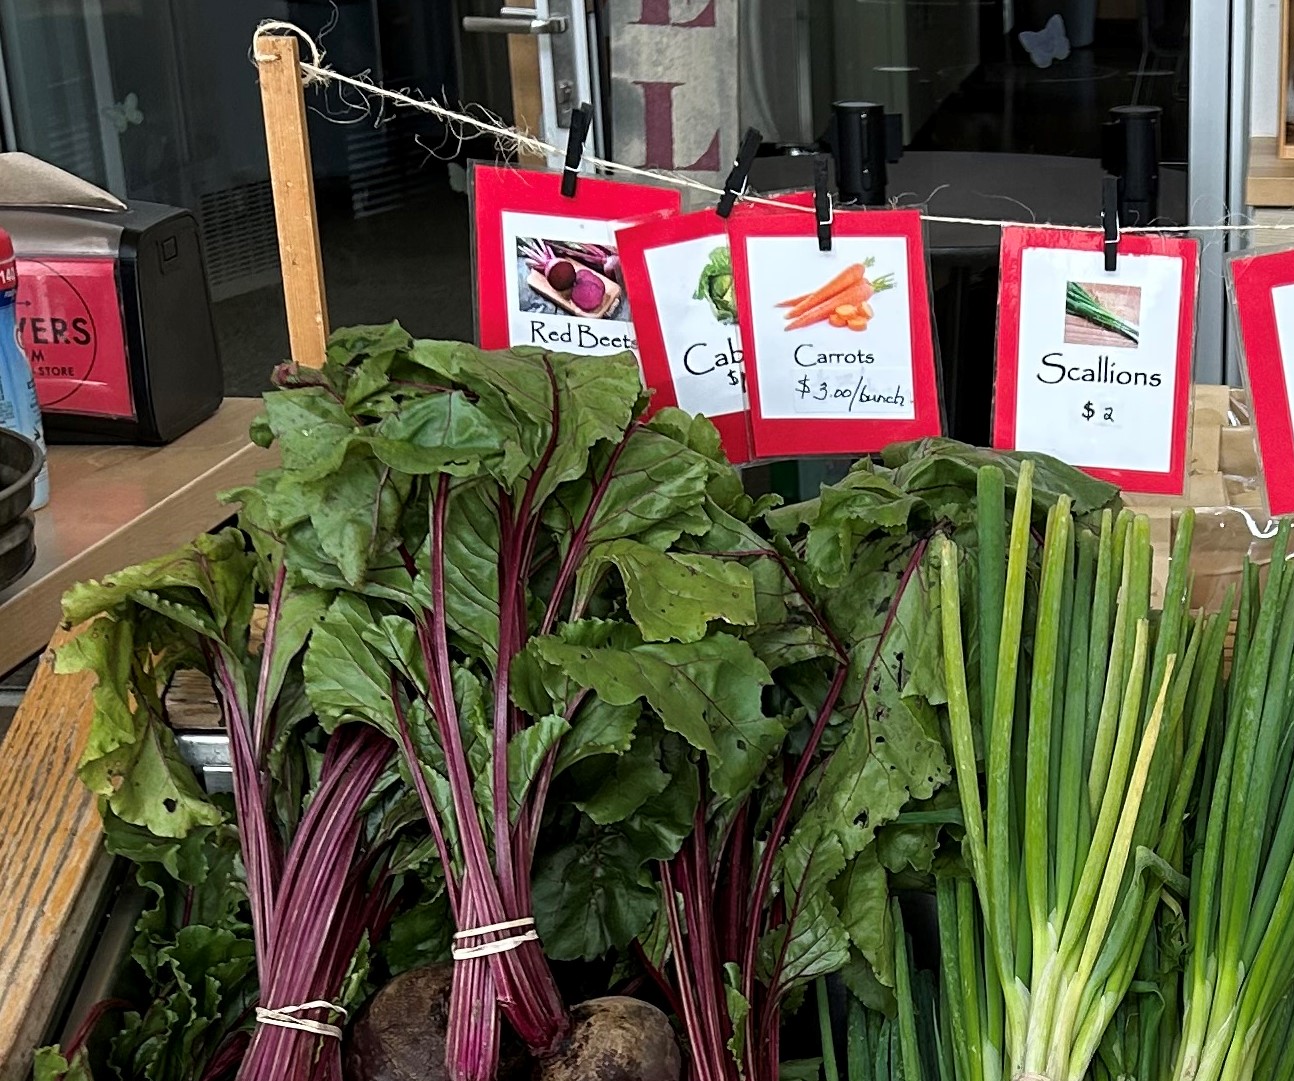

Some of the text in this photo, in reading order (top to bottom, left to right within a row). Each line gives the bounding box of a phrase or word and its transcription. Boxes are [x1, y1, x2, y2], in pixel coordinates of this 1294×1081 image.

[530, 320, 639, 349] Red Beets
[683, 337, 745, 376] Cab
[794, 343, 875, 367] Carrots
[1036, 352, 1162, 387] Scallions
[38, 366, 75, 377] STORE
